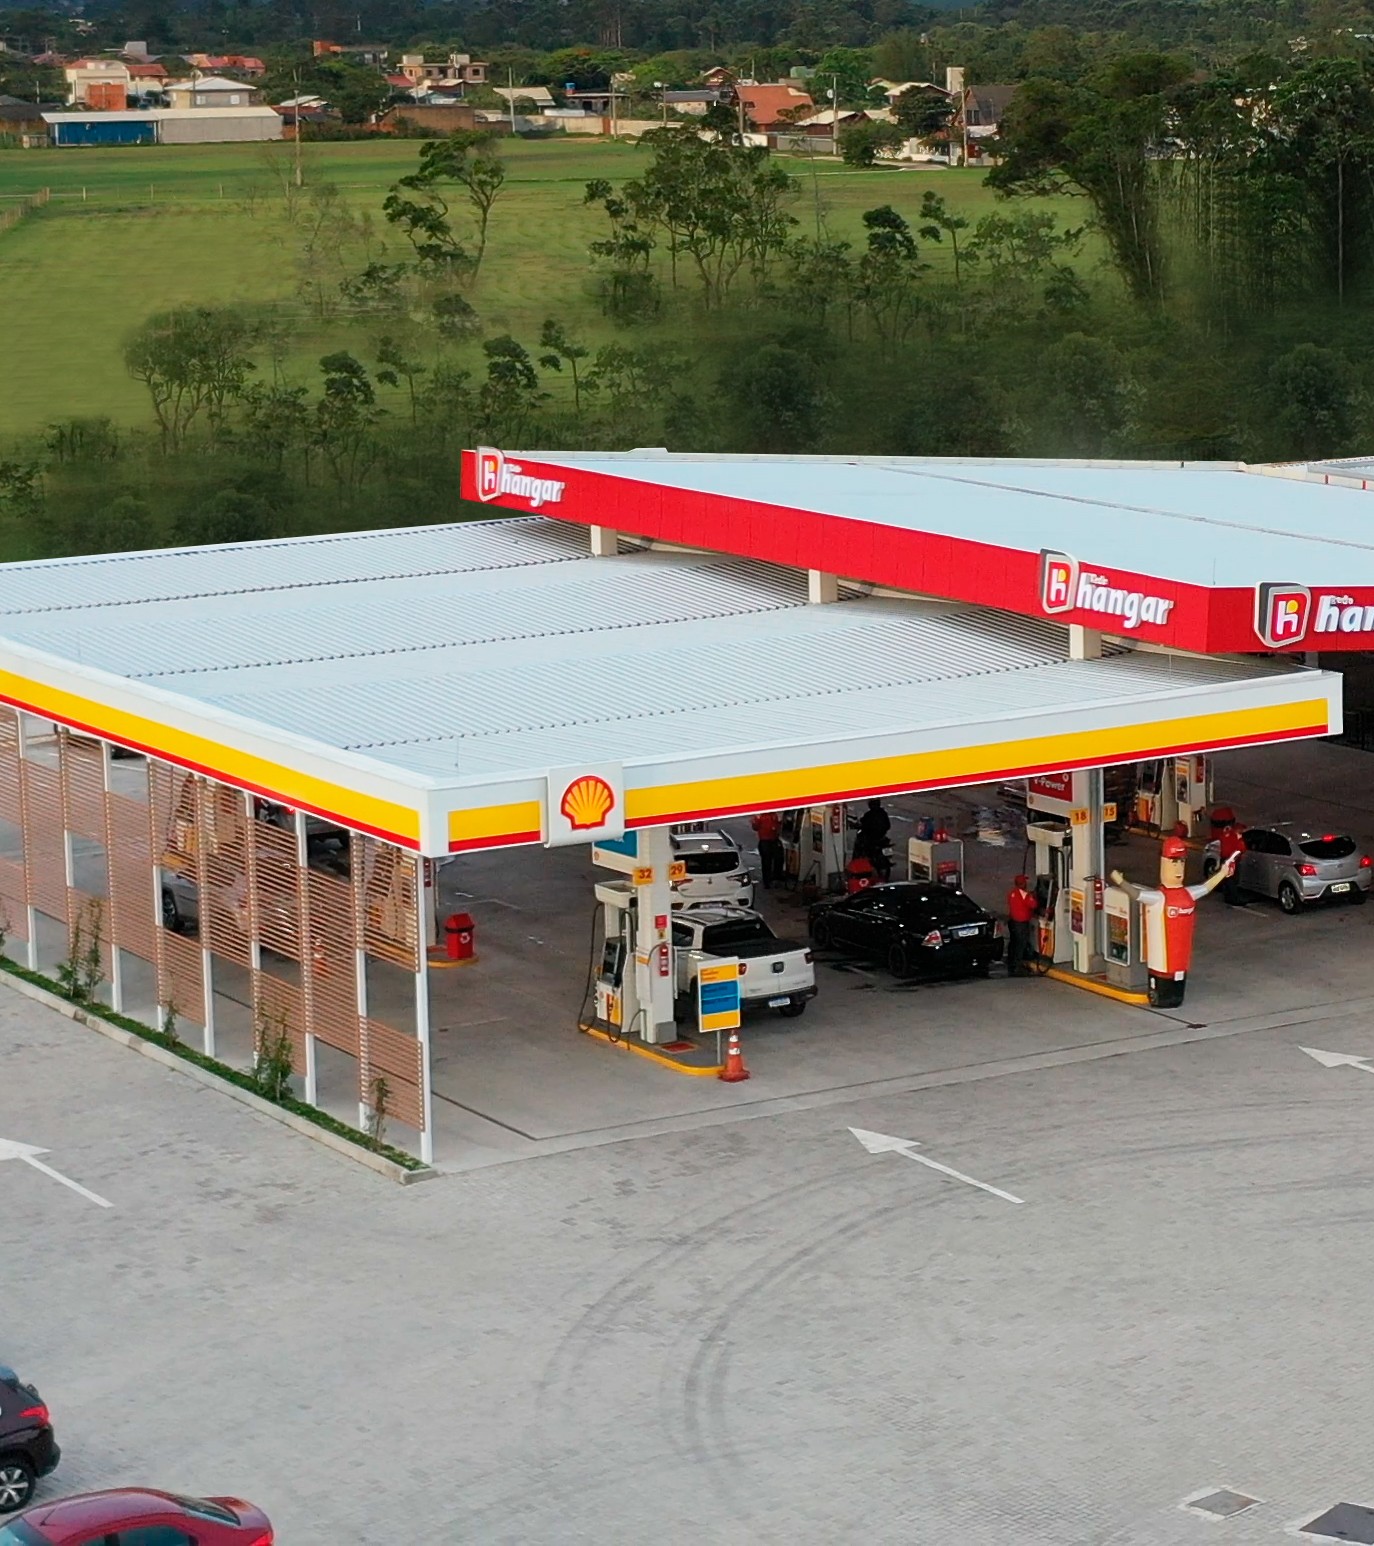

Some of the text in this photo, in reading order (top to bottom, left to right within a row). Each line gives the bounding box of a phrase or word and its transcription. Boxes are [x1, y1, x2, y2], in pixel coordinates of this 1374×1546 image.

[501, 464, 566, 507] hangar
[1076, 572, 1174, 628] hangar
[1075, 811, 1087, 822] 18
[639, 869, 653, 879] 32
[670, 864, 683, 875] 29
